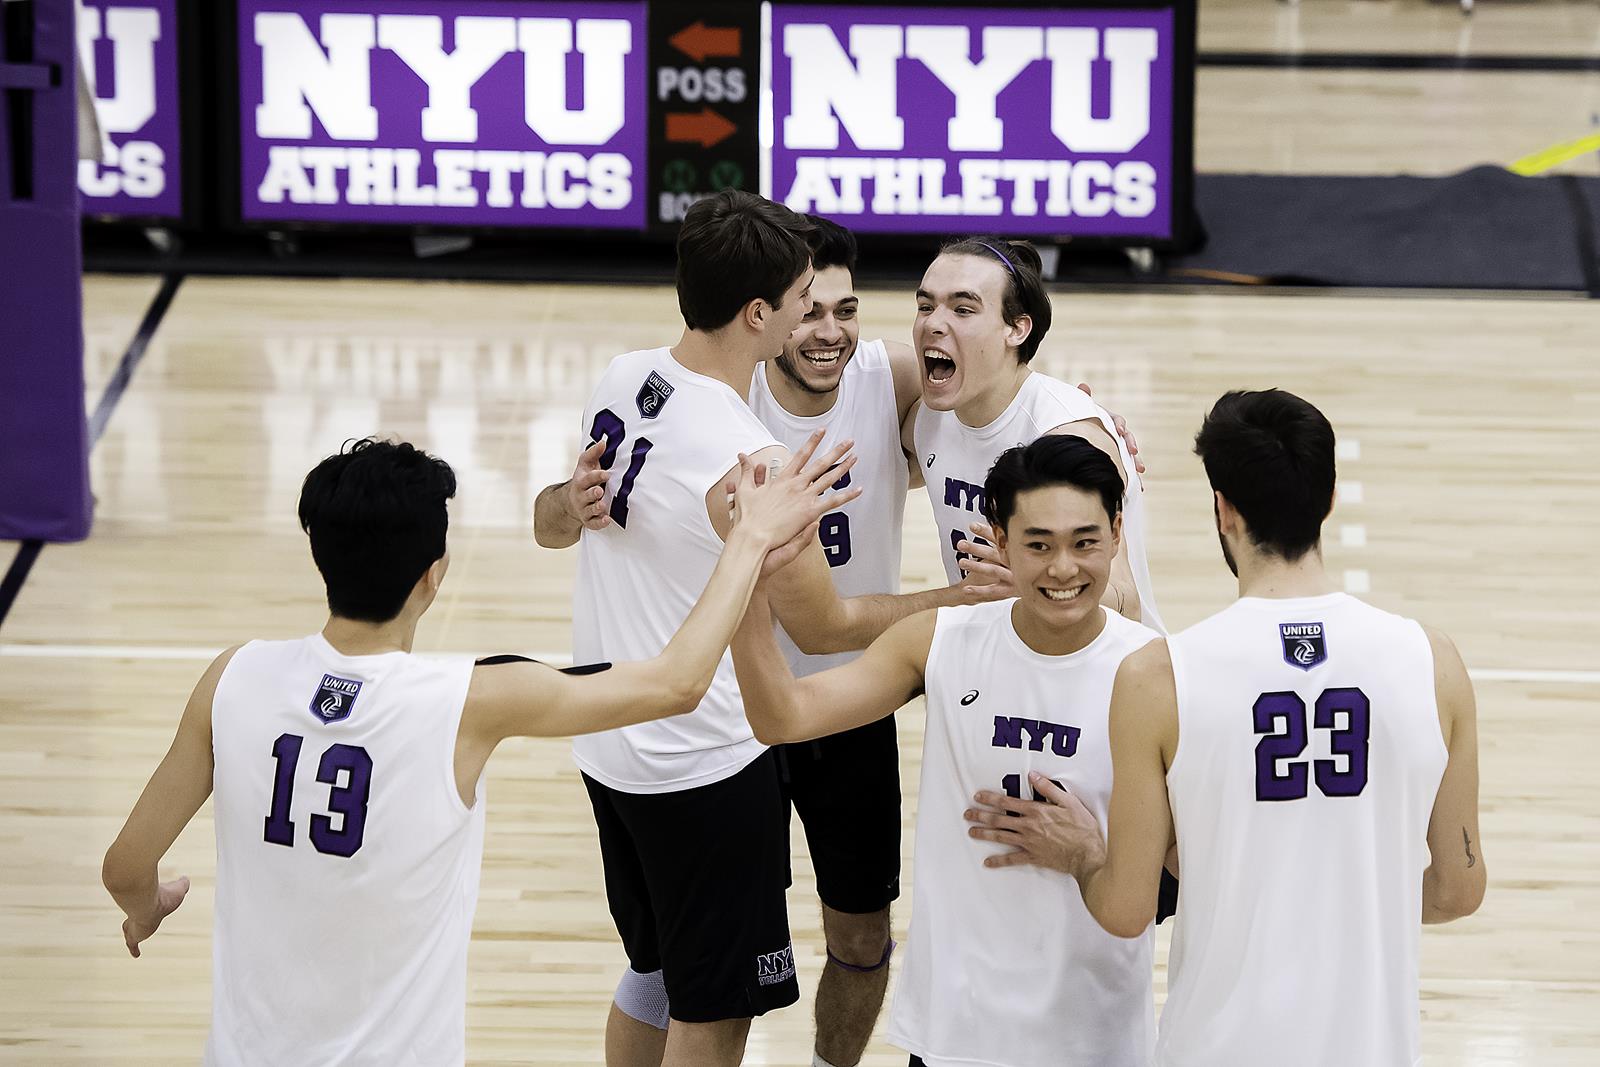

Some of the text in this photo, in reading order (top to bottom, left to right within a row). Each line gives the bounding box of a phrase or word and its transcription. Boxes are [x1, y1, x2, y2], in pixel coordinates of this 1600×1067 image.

[254, 12, 634, 146] NYU
[658, 67, 747, 103] POSS
[782, 23, 1160, 155] NYU
[258, 147, 634, 210] ATHLETICS
[784, 157, 1158, 218] ATHLETICS
[649, 374, 672, 397] UNITED
[585, 408, 653, 529] 21
[1282, 625, 1321, 636] UNITED
[323, 676, 359, 693] UNITED
[991, 715, 1082, 758] NYU
[1253, 688, 1371, 802] 23
[264, 733, 373, 857] 13
